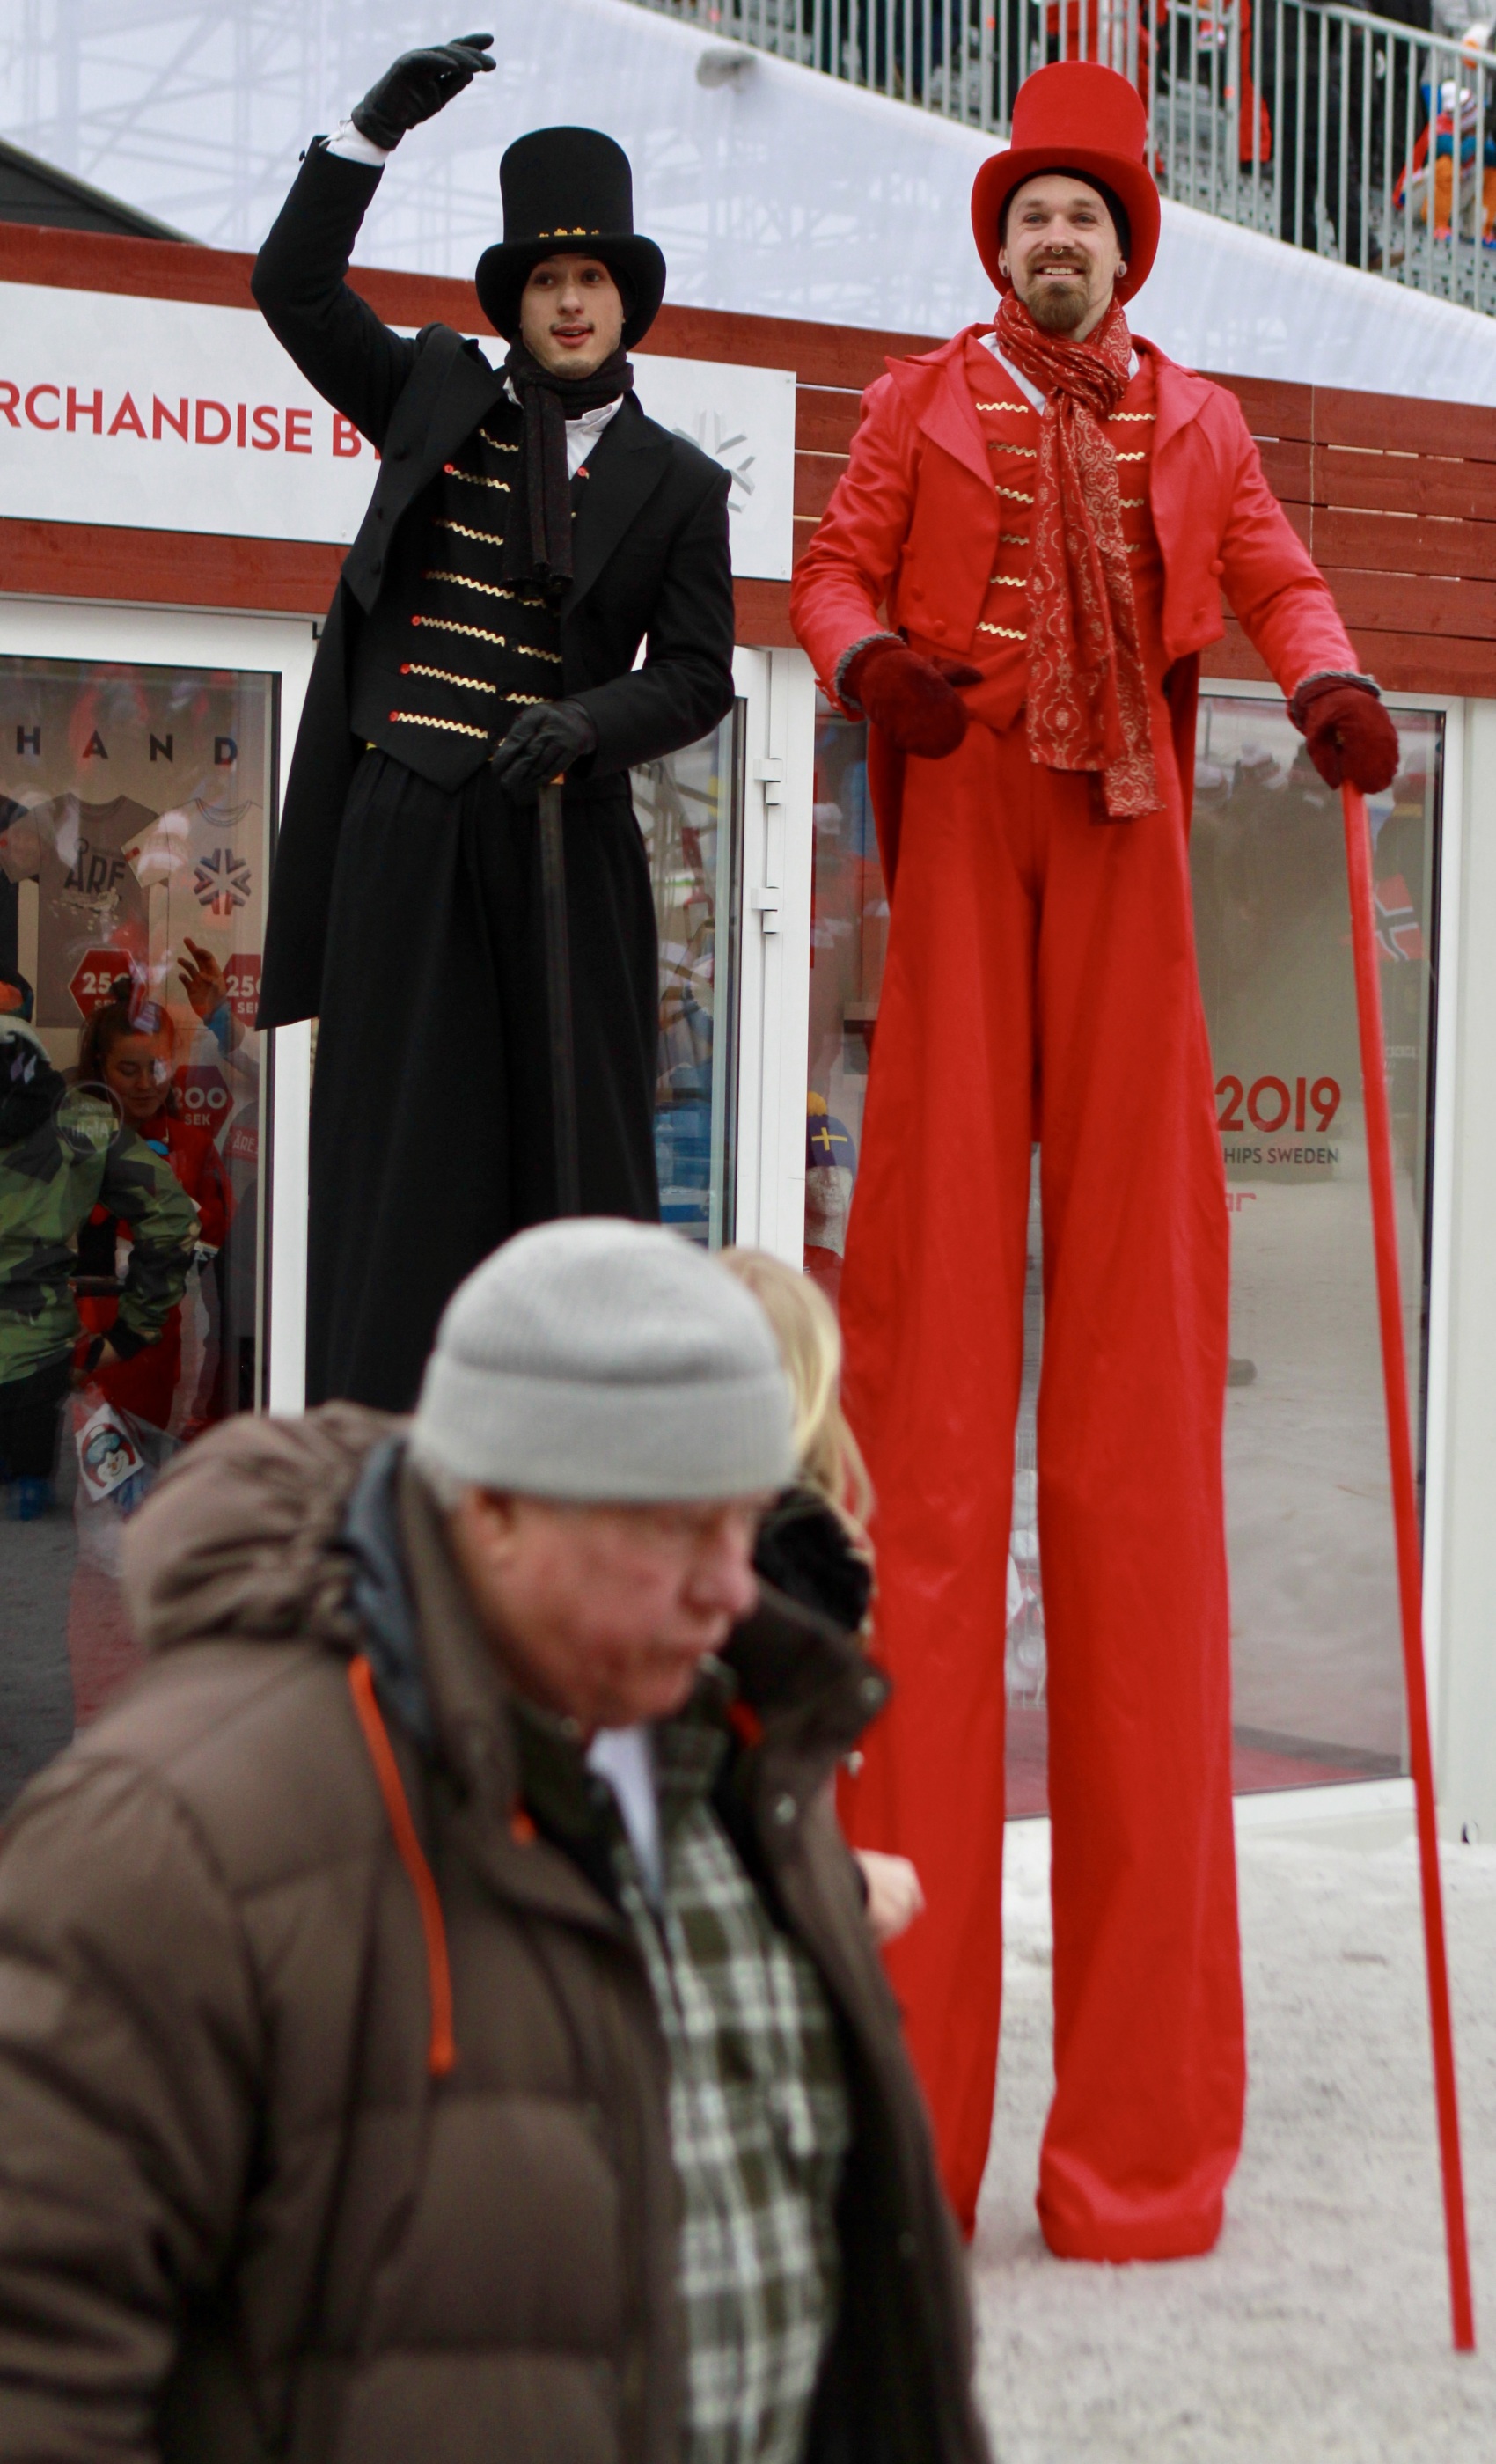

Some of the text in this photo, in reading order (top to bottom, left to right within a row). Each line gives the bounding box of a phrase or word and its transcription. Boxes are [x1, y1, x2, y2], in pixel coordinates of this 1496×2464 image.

[0, 379, 381, 460] RCHANDISE B
[225, 975, 261, 997] 25
[1214, 1074, 1341, 1133] 2019
[184, 1113, 211, 1126] SEK
[1267, 1147, 1339, 1165] SWEDEN
